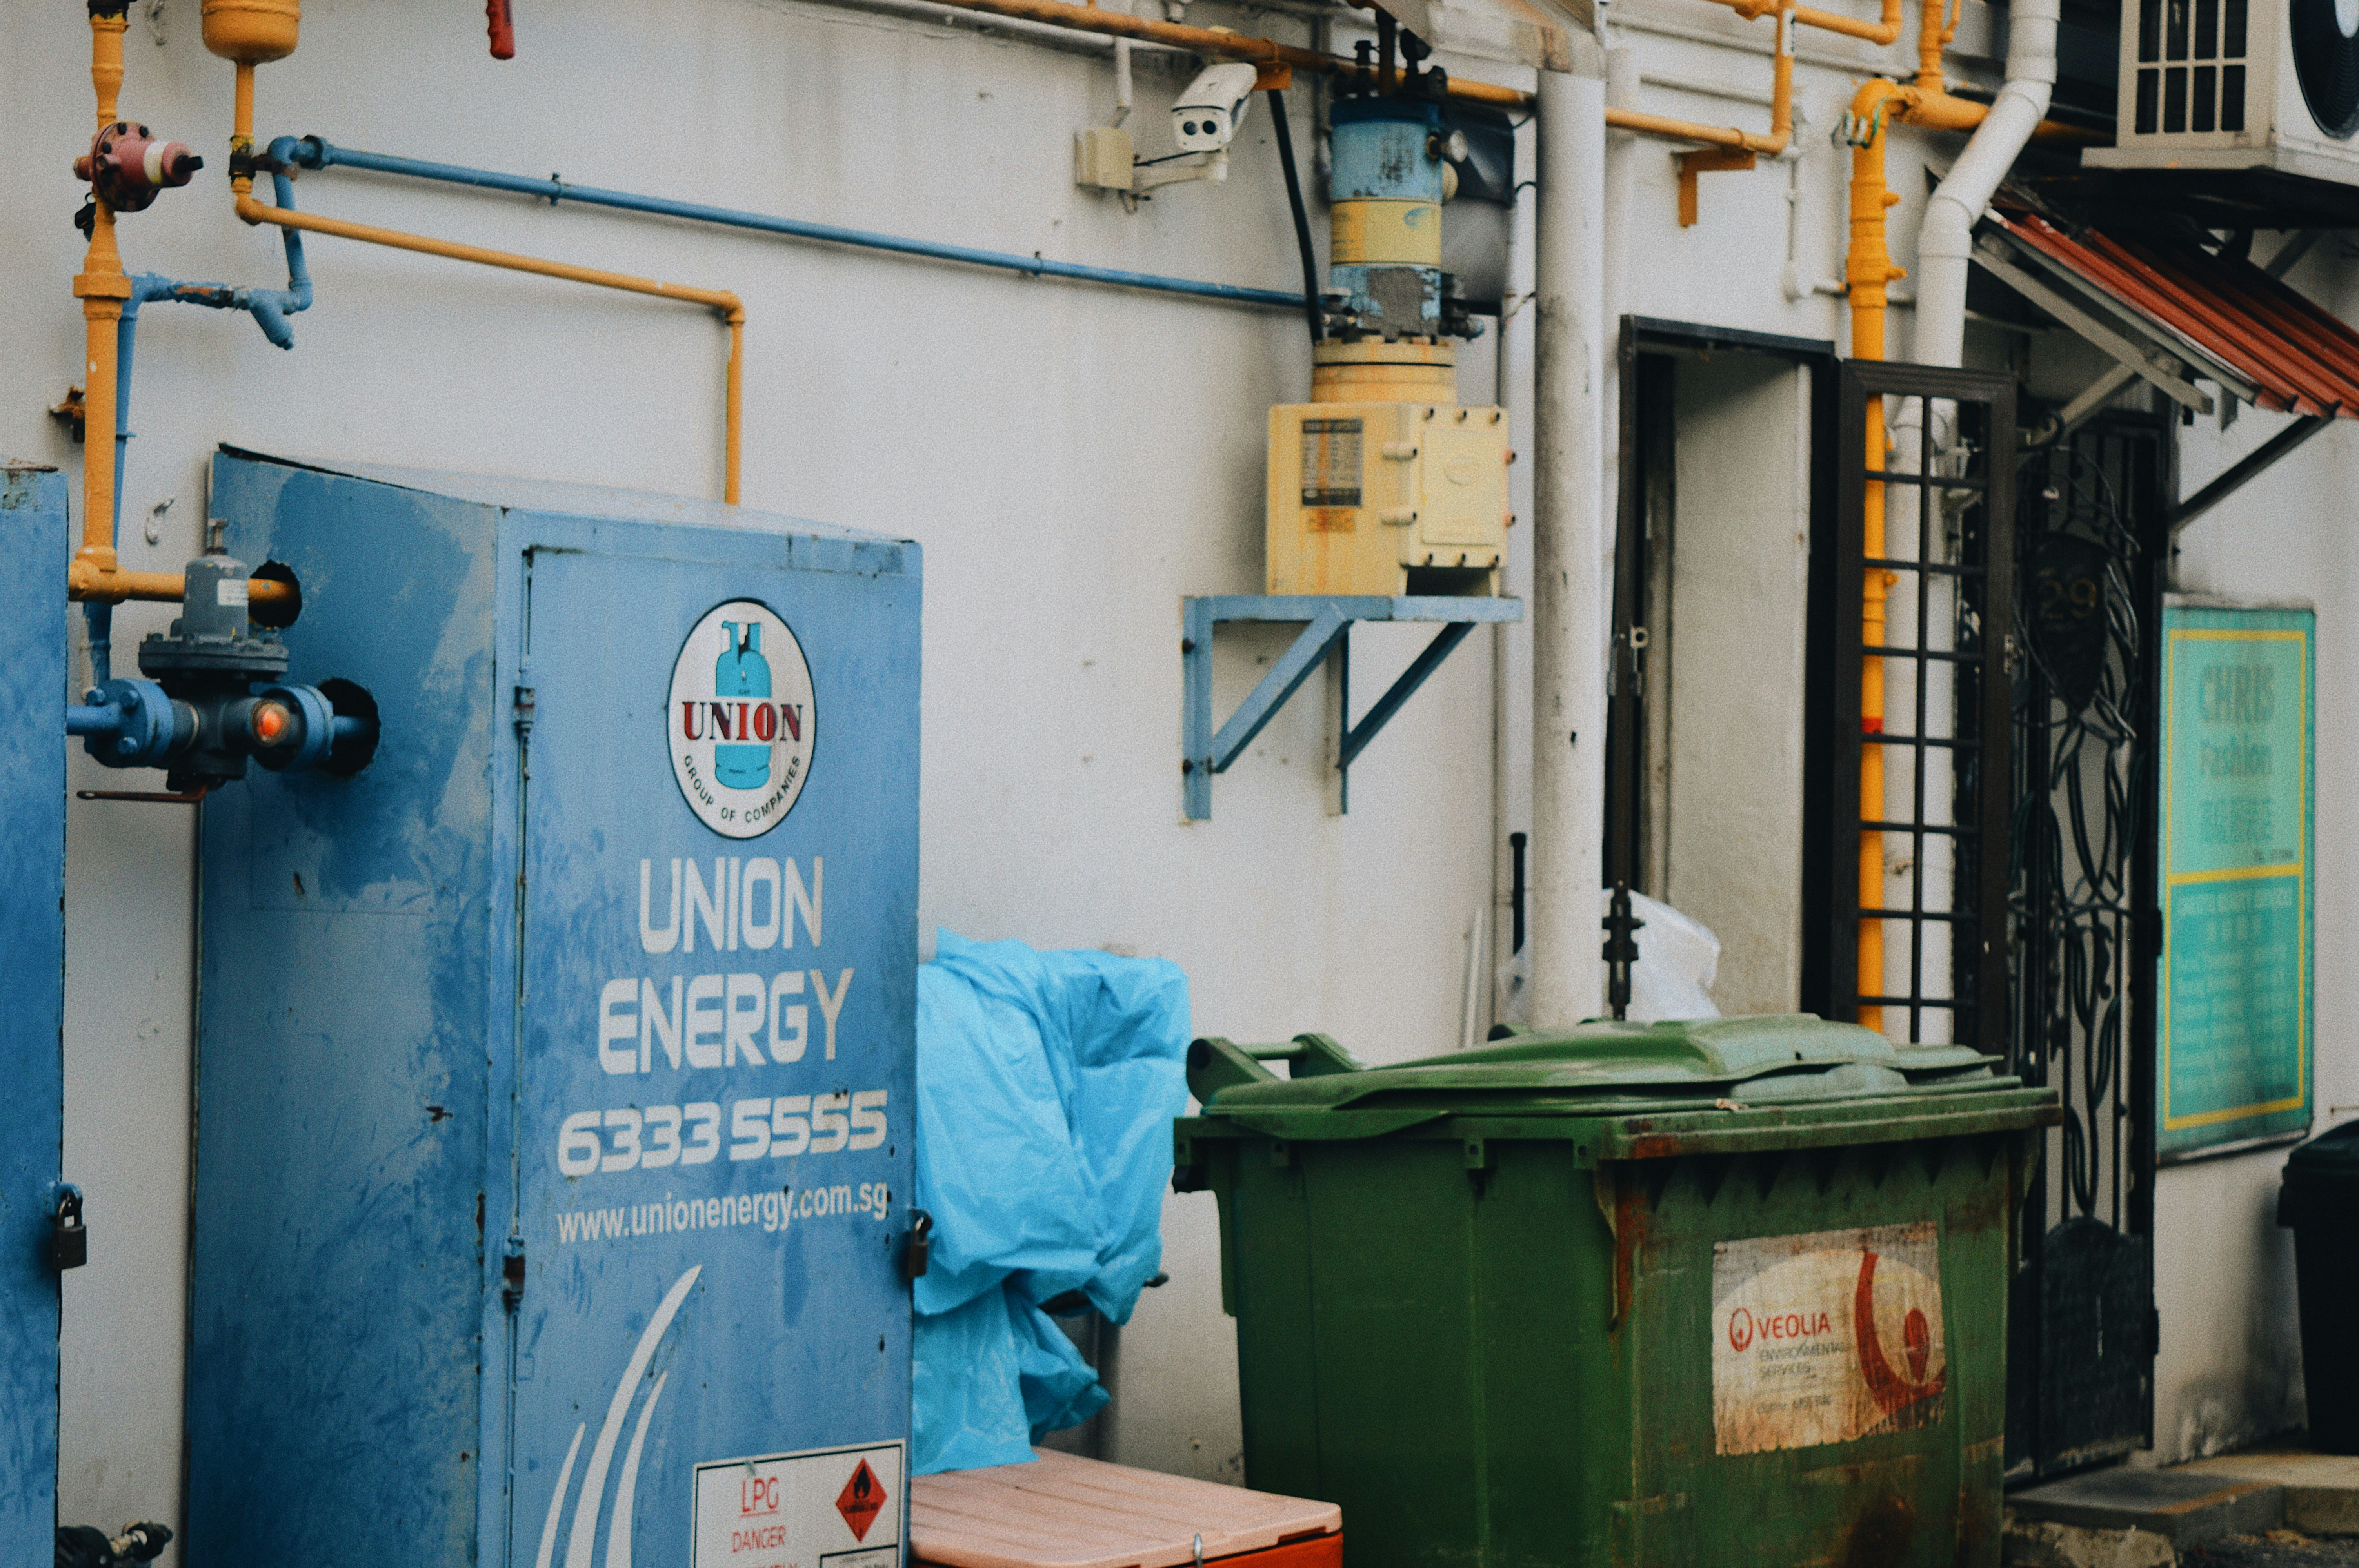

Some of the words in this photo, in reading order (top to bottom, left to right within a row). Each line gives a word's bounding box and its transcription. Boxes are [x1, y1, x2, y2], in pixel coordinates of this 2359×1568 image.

[682, 702, 803, 742] UNION
[684, 755, 714, 806] GROUP
[721, 807, 736, 822] OF
[745, 755, 800, 824] COMPANIES
[639, 856, 823, 954] UNION
[598, 968, 855, 1075] ENERGY
[557, 1181, 888, 1243] www.unionenergy.com.sg
[1757, 1311, 1831, 1340] VEOLIA
[742, 1476, 779, 1512] LPG
[732, 1524, 786, 1553] DANGER
